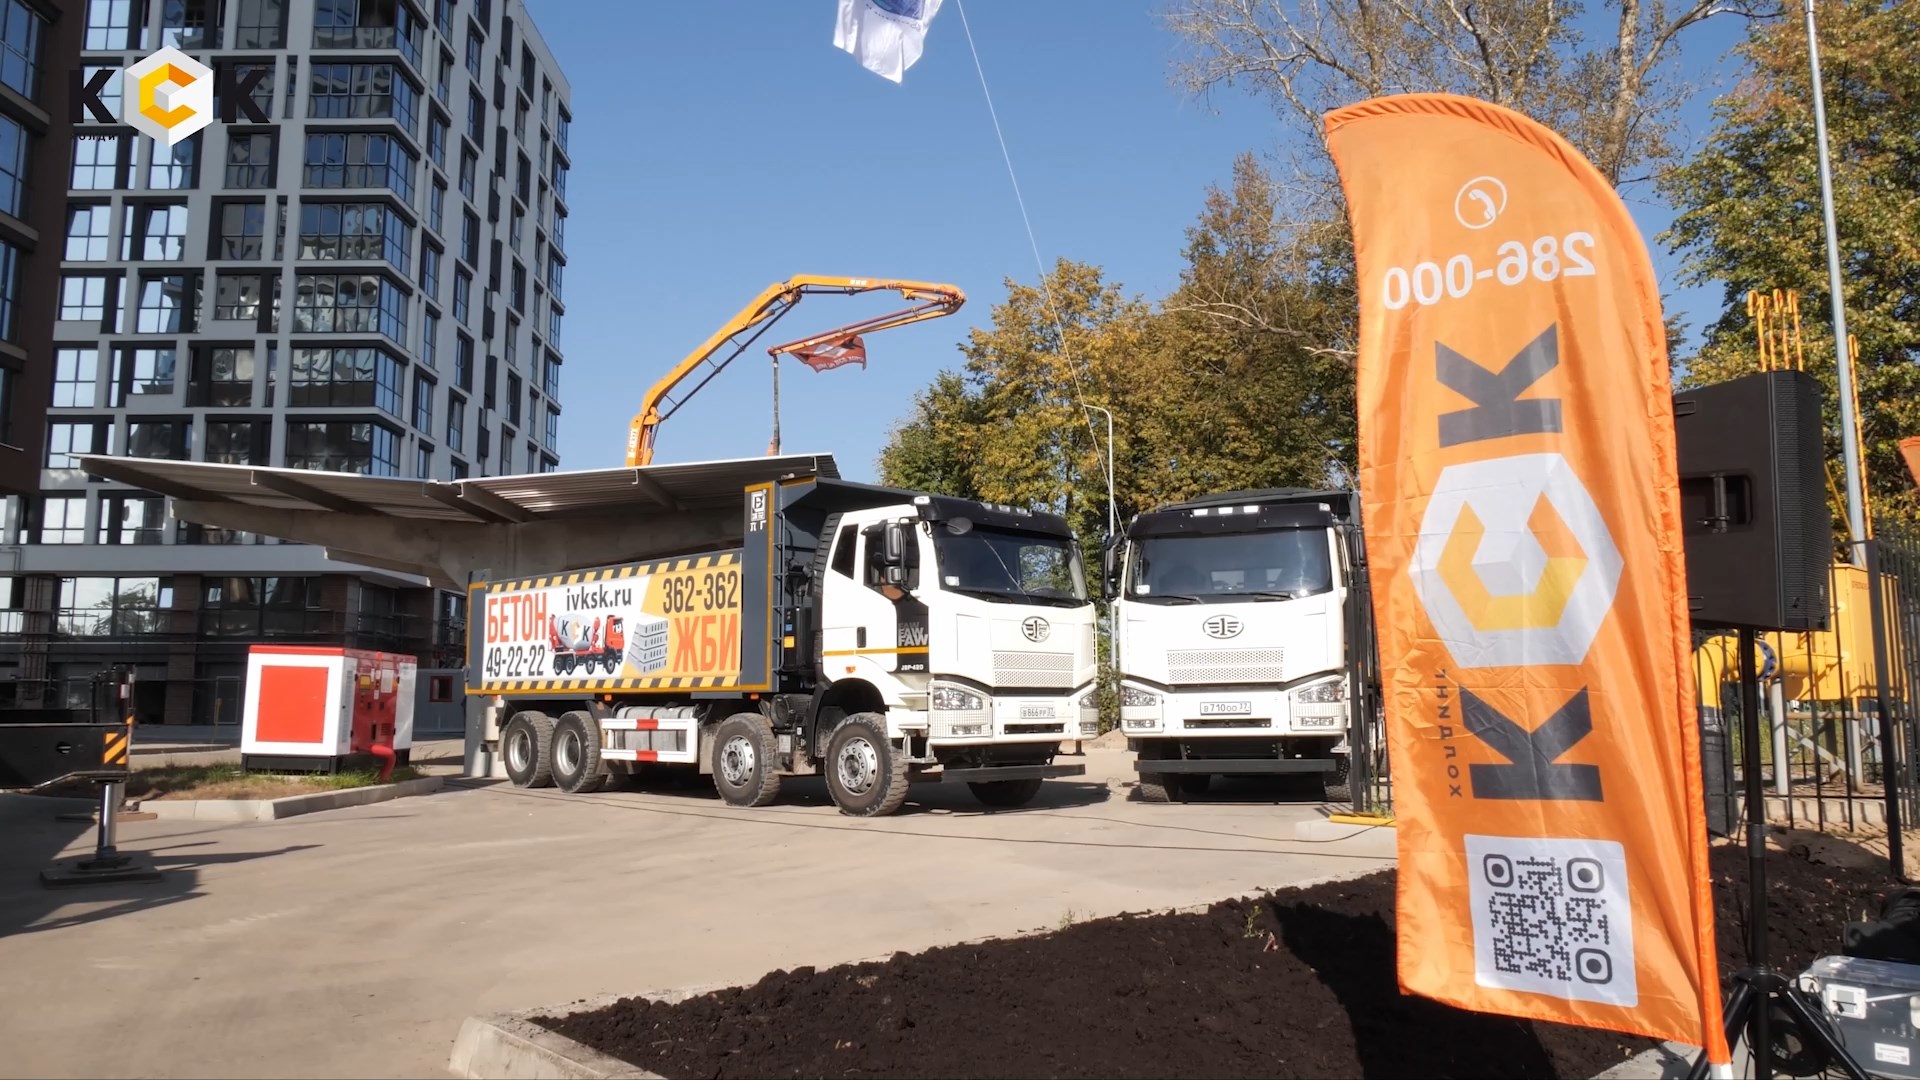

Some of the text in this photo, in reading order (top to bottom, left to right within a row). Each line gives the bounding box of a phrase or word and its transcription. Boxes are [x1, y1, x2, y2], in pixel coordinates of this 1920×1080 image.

[566, 584, 632, 611] ivksk.ru
[663, 570, 738, 614] 362-362
[487, 592, 547, 643] БЕТОН
[672, 613, 738, 673] ЖБИ
[898, 633, 929, 647] FAW
[485, 645, 545, 678] 49-22-22
